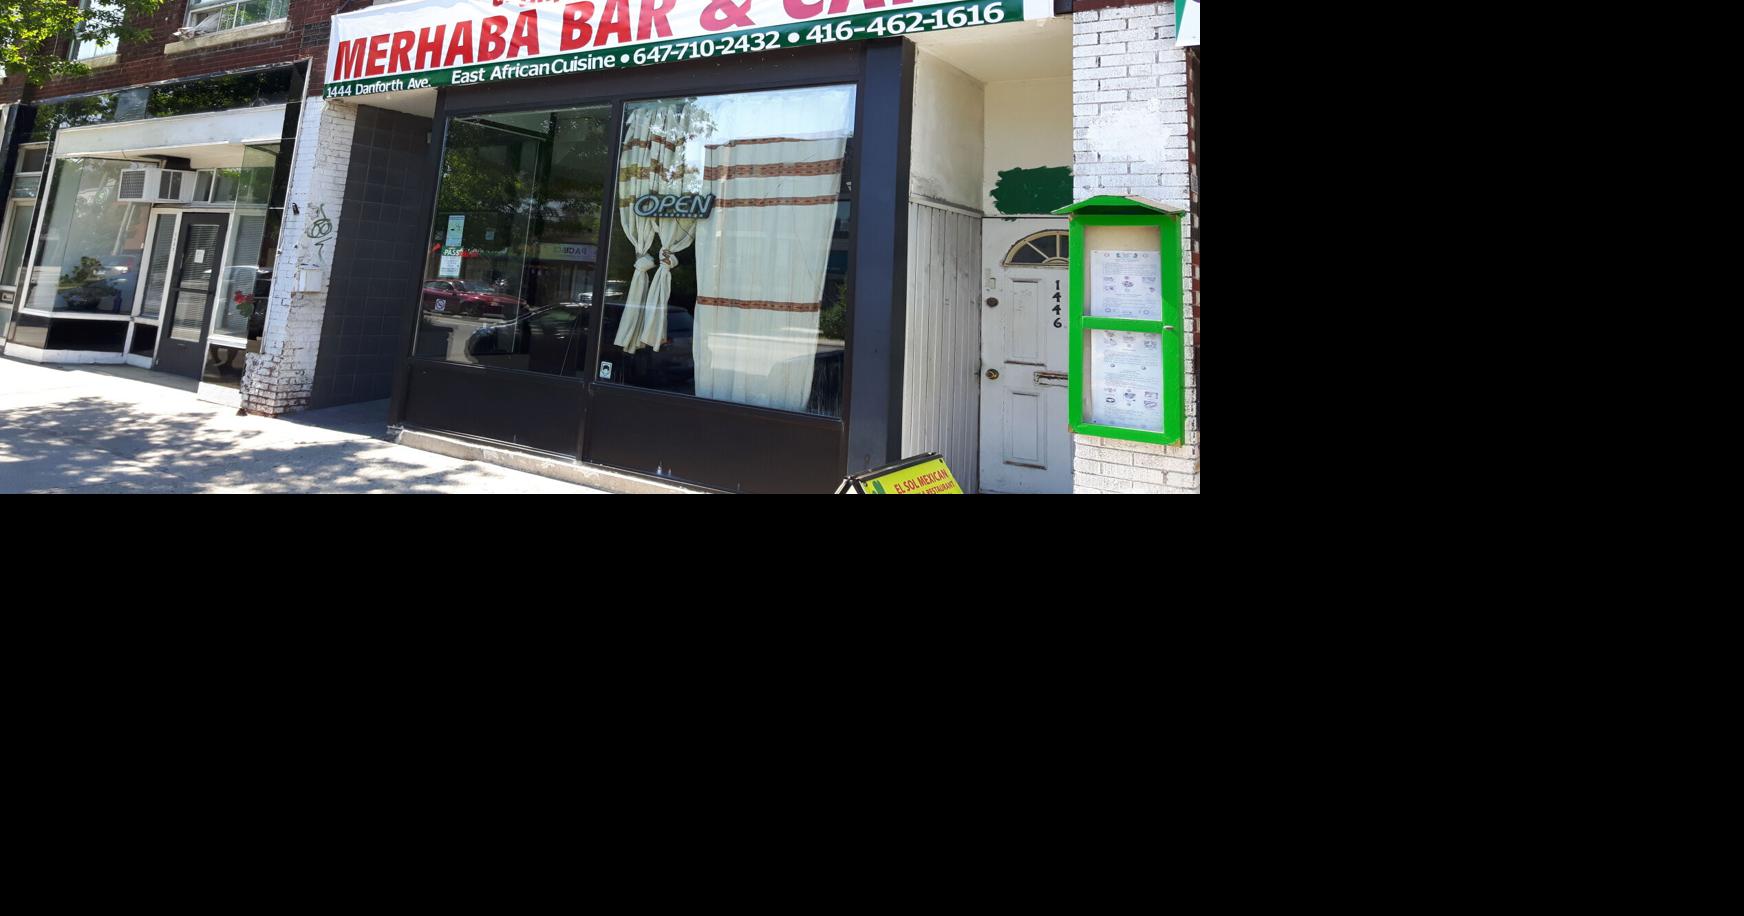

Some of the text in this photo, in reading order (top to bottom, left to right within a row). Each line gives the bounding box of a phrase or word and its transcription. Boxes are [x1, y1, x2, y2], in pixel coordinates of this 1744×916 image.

[333, 9, 540, 81] MERHABA
[560, 0, 676, 51] BAR
[451, 68, 485, 85] East
[490, 62, 550, 80] African
[551, 53, 615, 75] Cuisine
[633, 30, 781, 65] 647-710-2432
[806, 1, 1004, 43] 416-462-1616
[327, 78, 431, 98] 1444 Danforth Ave.
[633, 194, 712, 216] OPEN
[1052, 280, 1062, 328] 1446
[894, 483, 906, 494] EL
[903, 479, 920, 491] SOL
[917, 469, 949, 487] MEXICAN
